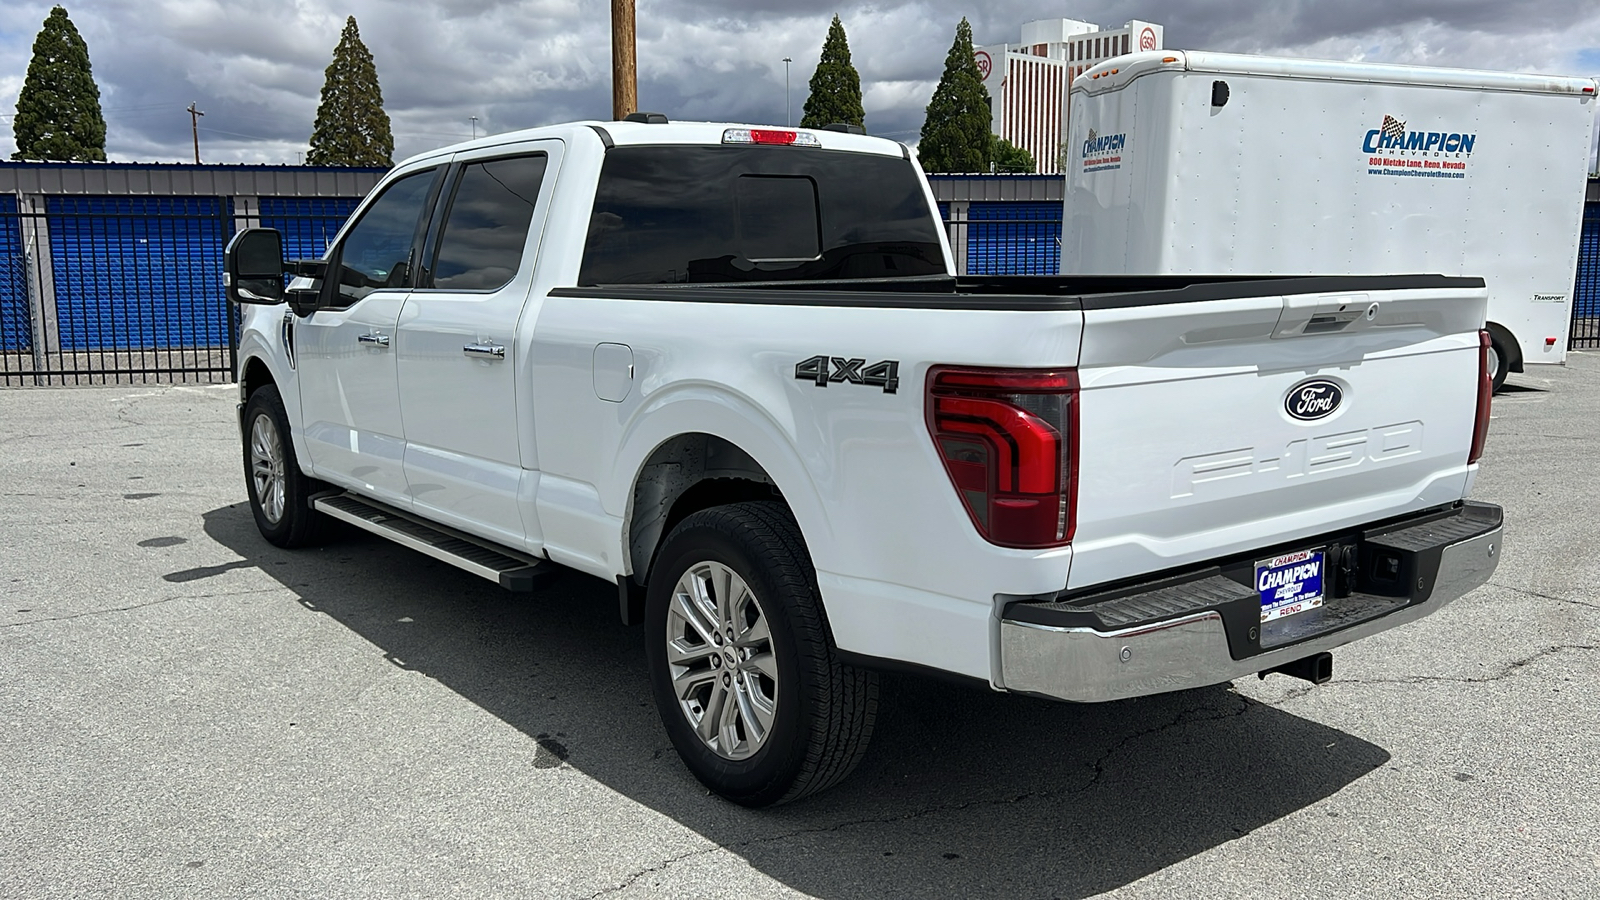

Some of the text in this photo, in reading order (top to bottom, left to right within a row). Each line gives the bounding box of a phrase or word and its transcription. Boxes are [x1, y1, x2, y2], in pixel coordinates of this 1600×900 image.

[1082, 133, 1126, 158] CHAMPION
[1362, 129, 1476, 153] CHAMPION
[1377, 148, 1471, 159] CHEVROLET
[1369, 157, 1466, 170] 800 Kietzke Lane, Reno, Nevada
[1368, 168, 1465, 179] www.ChampionChevroletReno.com
[1297, 387, 1334, 414] Ford
[1170, 420, 1424, 499] F-150
[1274, 552, 1308, 566] CHAMPION
[1259, 562, 1319, 591] CHAMPION
[1277, 585, 1301, 596] CHEVROLET
[1280, 605, 1301, 616] RENO
